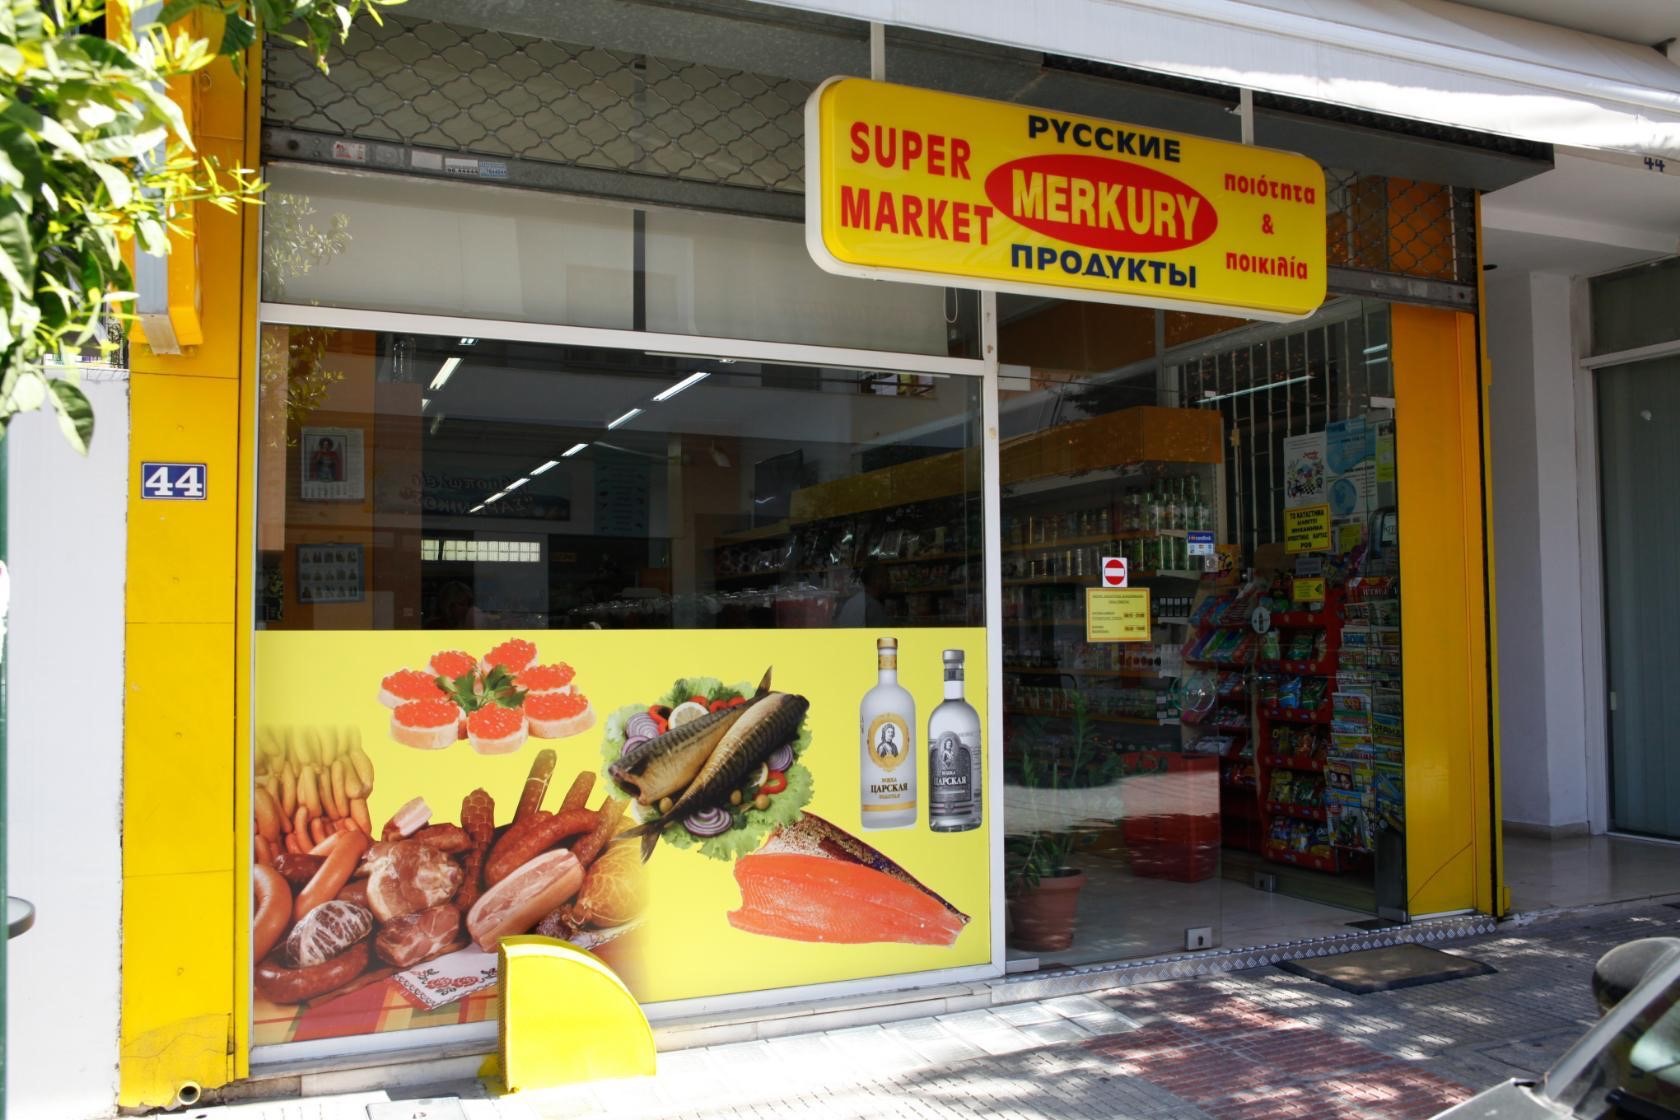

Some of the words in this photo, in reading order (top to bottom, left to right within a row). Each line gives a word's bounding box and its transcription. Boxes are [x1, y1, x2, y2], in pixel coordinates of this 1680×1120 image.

[850, 121, 971, 180] SUPER
[1028, 115, 1181, 163] РУССКИЕ
[1643, 156, 1666, 173] 44
[1012, 168, 1202, 241] MERKURY
[1224, 171, 1316, 206] ποιότητα
[840, 185, 994, 246] MARKET
[1261, 213, 1275, 235] &
[1011, 243, 1197, 288] ПРОДУКТЫ
[1226, 251, 1309, 280] ποικιλία
[145, 466, 202, 497] 44
[870, 782, 908, 794] ЦАРСКАЯ
